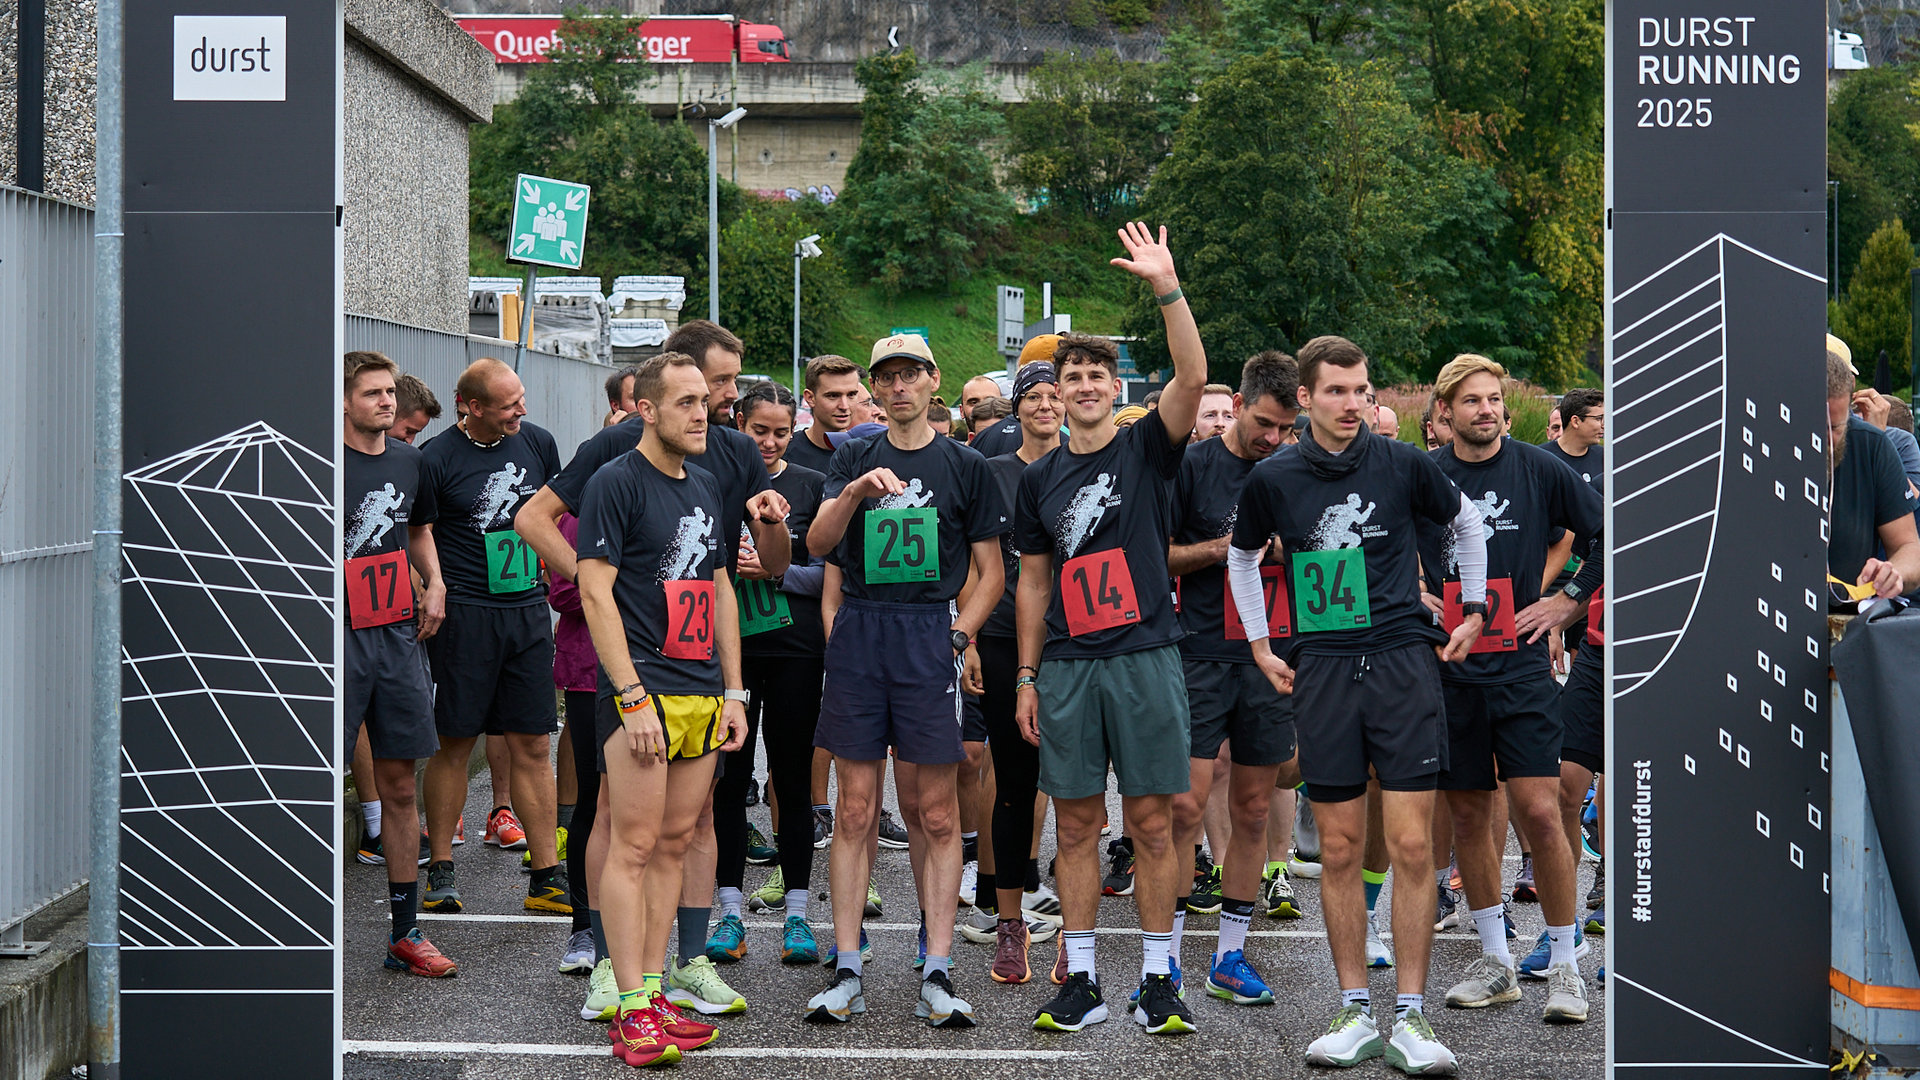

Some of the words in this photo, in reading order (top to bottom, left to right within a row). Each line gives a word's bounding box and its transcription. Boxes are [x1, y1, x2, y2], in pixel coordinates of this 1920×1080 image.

[494, 29, 692, 61] Quehrger
[1638, 16, 1756, 47] DURST
[191, 36, 271, 72] durst
[1638, 54, 1801, 85] RUNNING
[1637, 98, 1713, 128] 2025
[877, 517, 926, 568] 25
[1361, 524, 1381, 533] DURST
[1362, 530, 1389, 538] RUNNING
[497, 538, 529, 580] 21
[361, 561, 397, 611] 17
[1072, 561, 1123, 617] 14
[1304, 560, 1356, 615] 34
[678, 590, 709, 643] 23
[1631, 759, 1652, 922] #durstaufdurst
[1214, 971, 1245, 990] BROOKS
